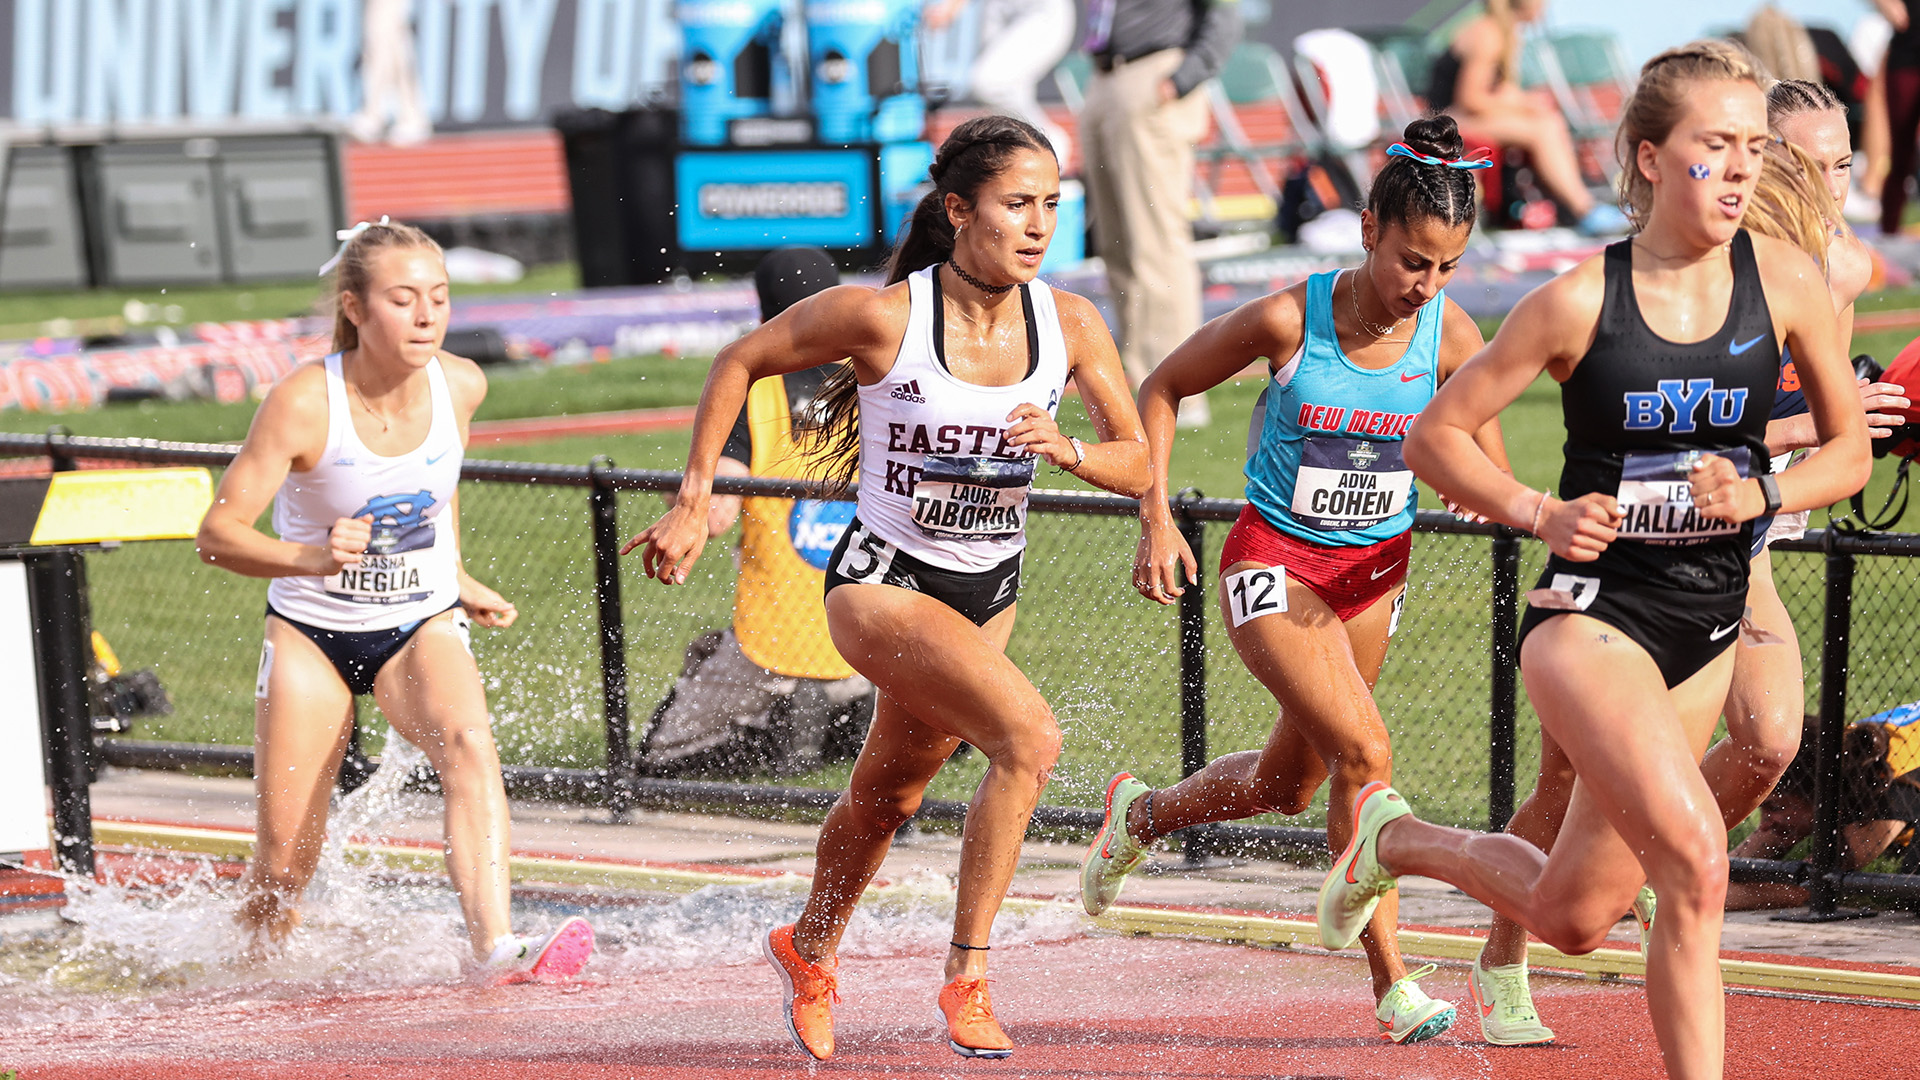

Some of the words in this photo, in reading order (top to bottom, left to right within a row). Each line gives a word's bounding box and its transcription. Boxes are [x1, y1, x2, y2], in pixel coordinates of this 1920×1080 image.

[9, 0, 561, 121] UNIVERITY
[1776, 363, 1801, 392] S
[890, 391, 926, 404] adidas
[1623, 378, 1748, 433] BYU
[1297, 402, 1346, 432] NEW
[887, 422, 1035, 459] EASTE
[950, 484, 999, 506] LAURA
[1338, 473, 1377, 489] ADVA
[1666, 484, 1694, 503] LEX
[914, 496, 1020, 531] TABORDA
[1311, 488, 1394, 516] COHEN
[1616, 504, 1738, 533] HALLADA
[360, 556, 405, 570] SASHA
[846, 531, 887, 580] 5
[341, 568, 420, 592] NEGLIA
[1232, 571, 1279, 618] 12
